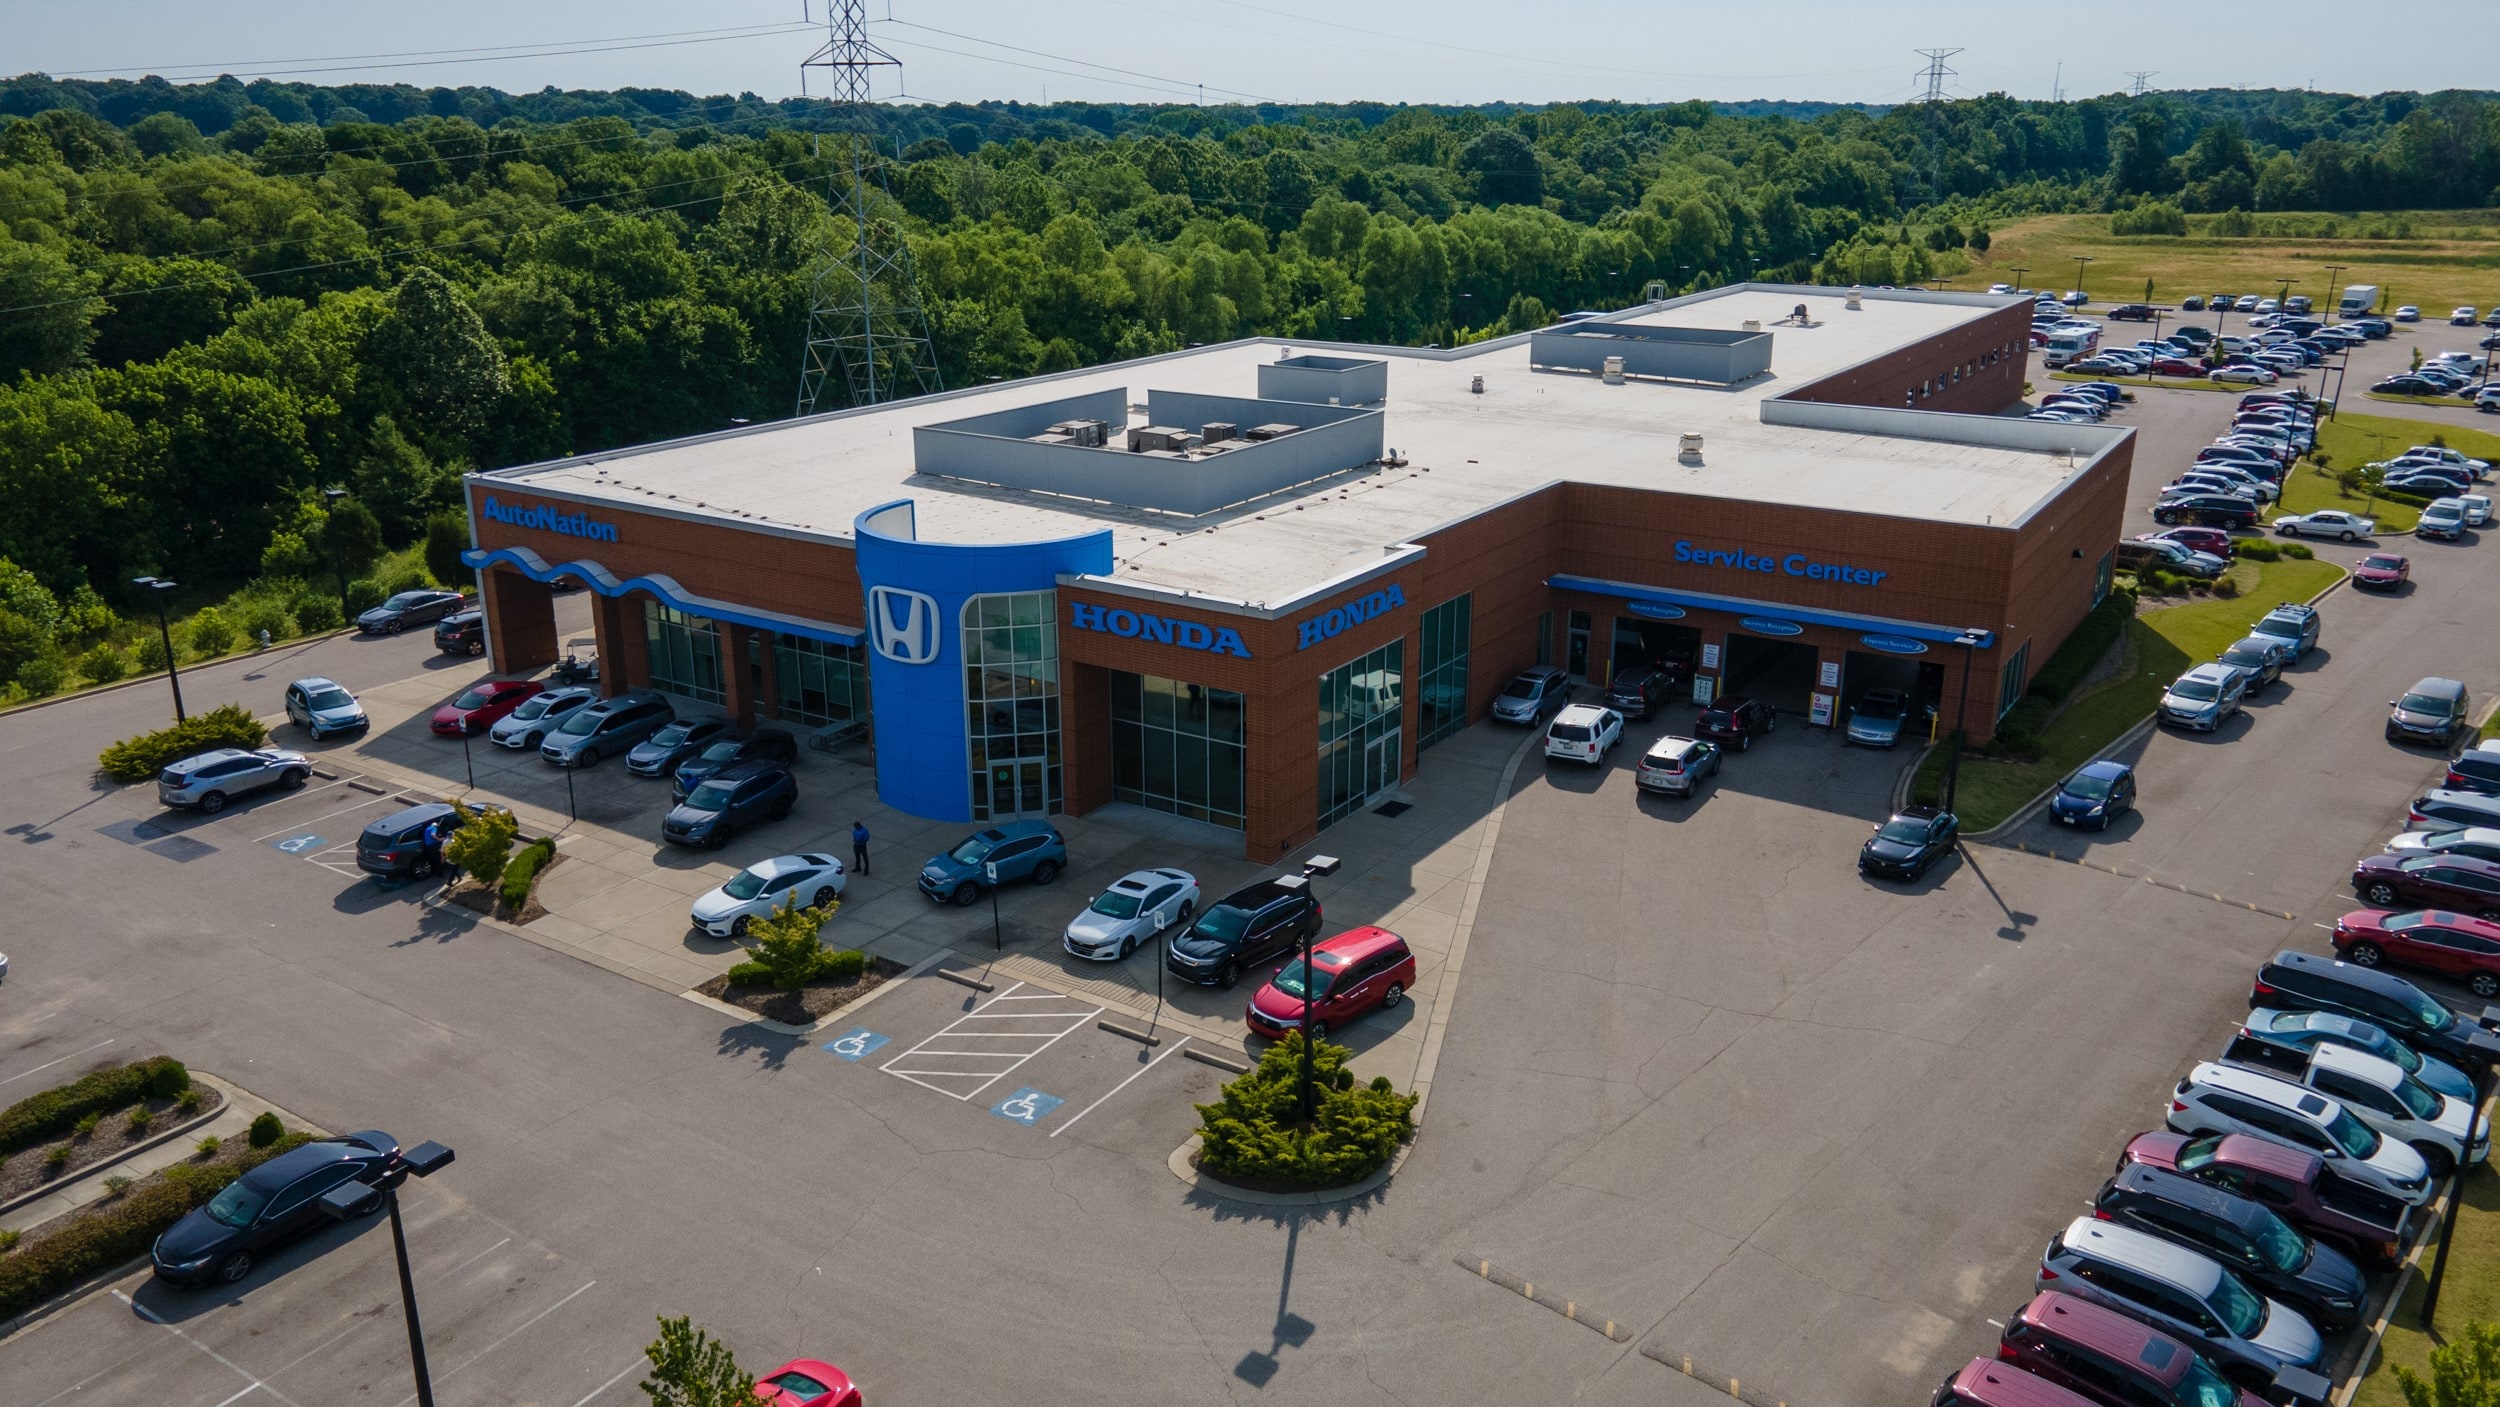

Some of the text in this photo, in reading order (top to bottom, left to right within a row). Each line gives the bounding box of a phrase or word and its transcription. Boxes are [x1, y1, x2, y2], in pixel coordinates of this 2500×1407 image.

[483, 496, 618, 543] AutoNation
[1673, 540, 1887, 586] Service Center
[1071, 601, 1253, 659] HONDA
[1298, 582, 1407, 651] HONDA
